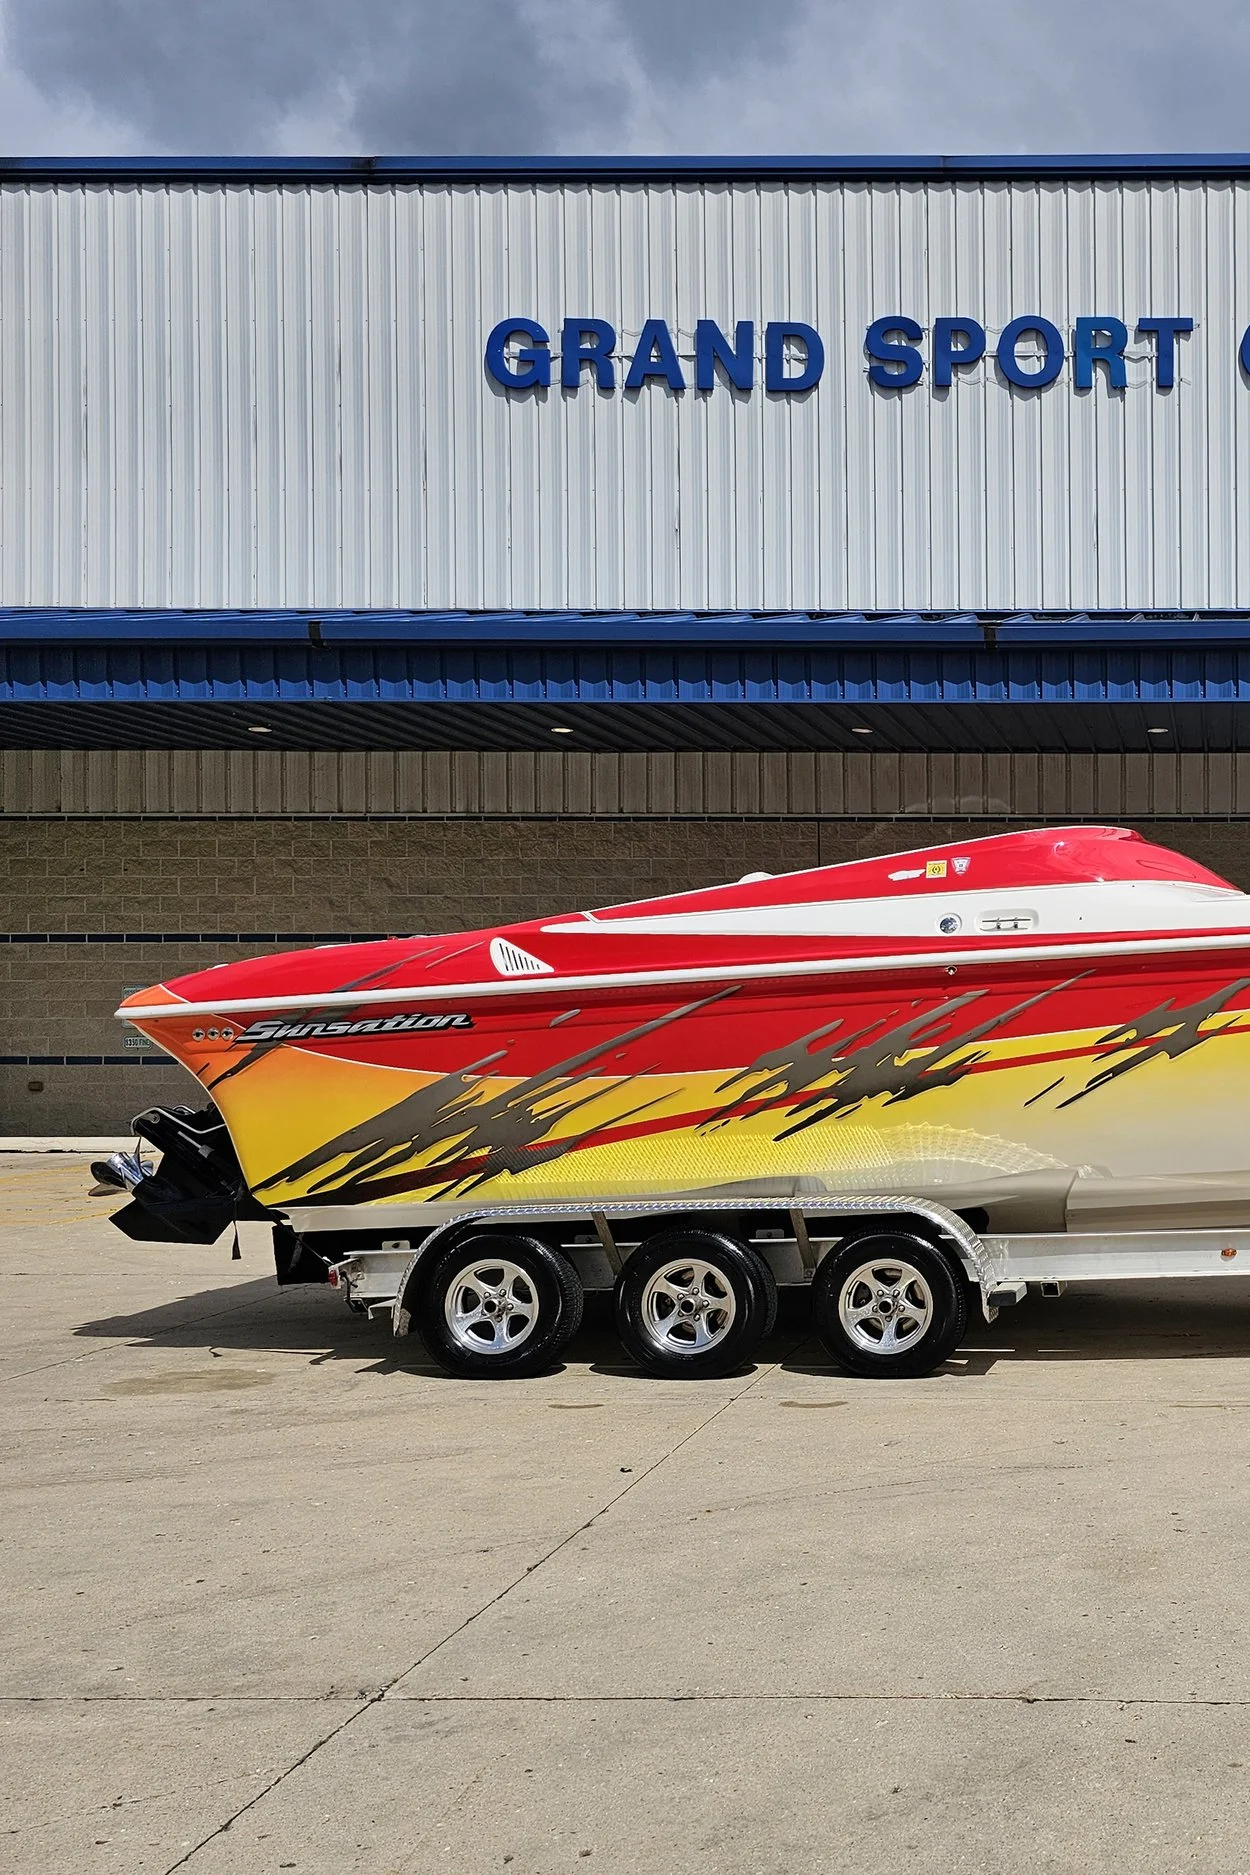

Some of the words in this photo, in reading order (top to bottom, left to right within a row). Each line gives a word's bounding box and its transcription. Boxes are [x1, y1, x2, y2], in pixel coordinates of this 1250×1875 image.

[485, 317, 825, 391] GRAND
[866, 315, 1195, 389] SPORT
[234, 1013, 472, 1043] Sunsation
